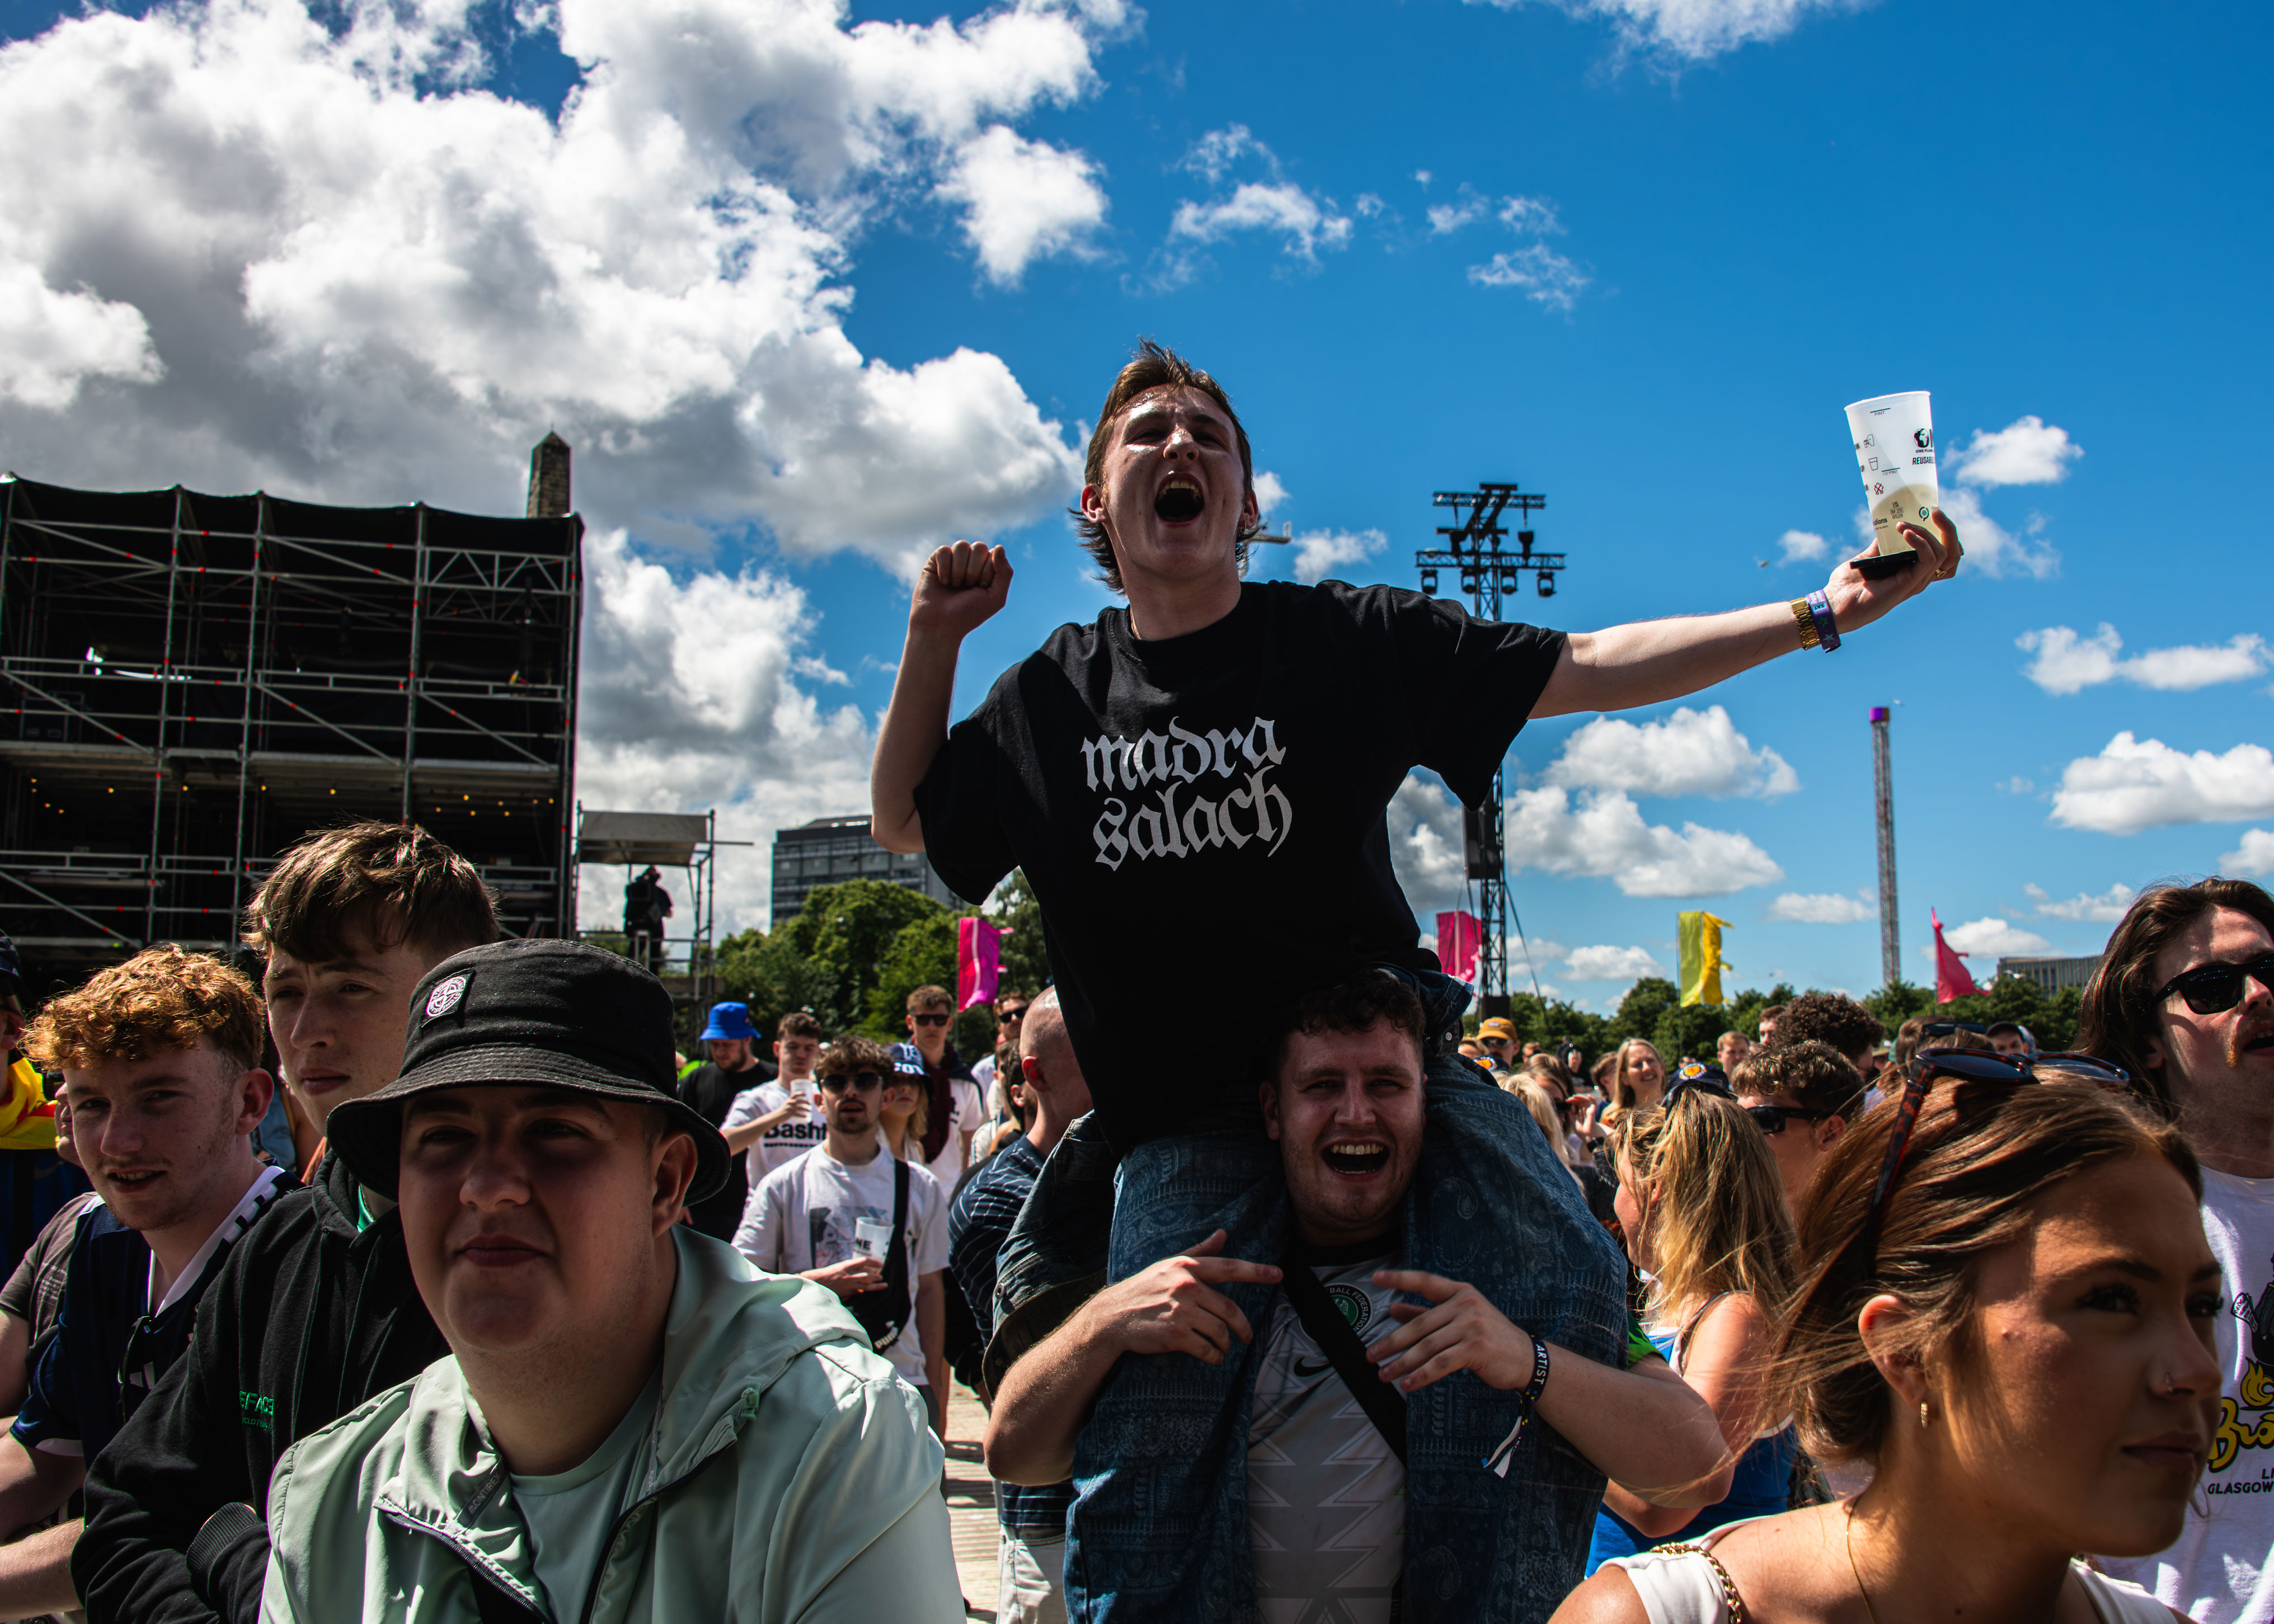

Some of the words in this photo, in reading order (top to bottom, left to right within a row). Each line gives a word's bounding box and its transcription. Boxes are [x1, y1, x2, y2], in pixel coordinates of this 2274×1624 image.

[1080, 716, 1286, 792] madra
[1093, 765, 1293, 872] salach
[1352, 1291, 1369, 1332] FEDERATION
[1534, 1344, 1548, 1385] ARTIST
[2207, 1481, 2274, 1495] GLASGOW
